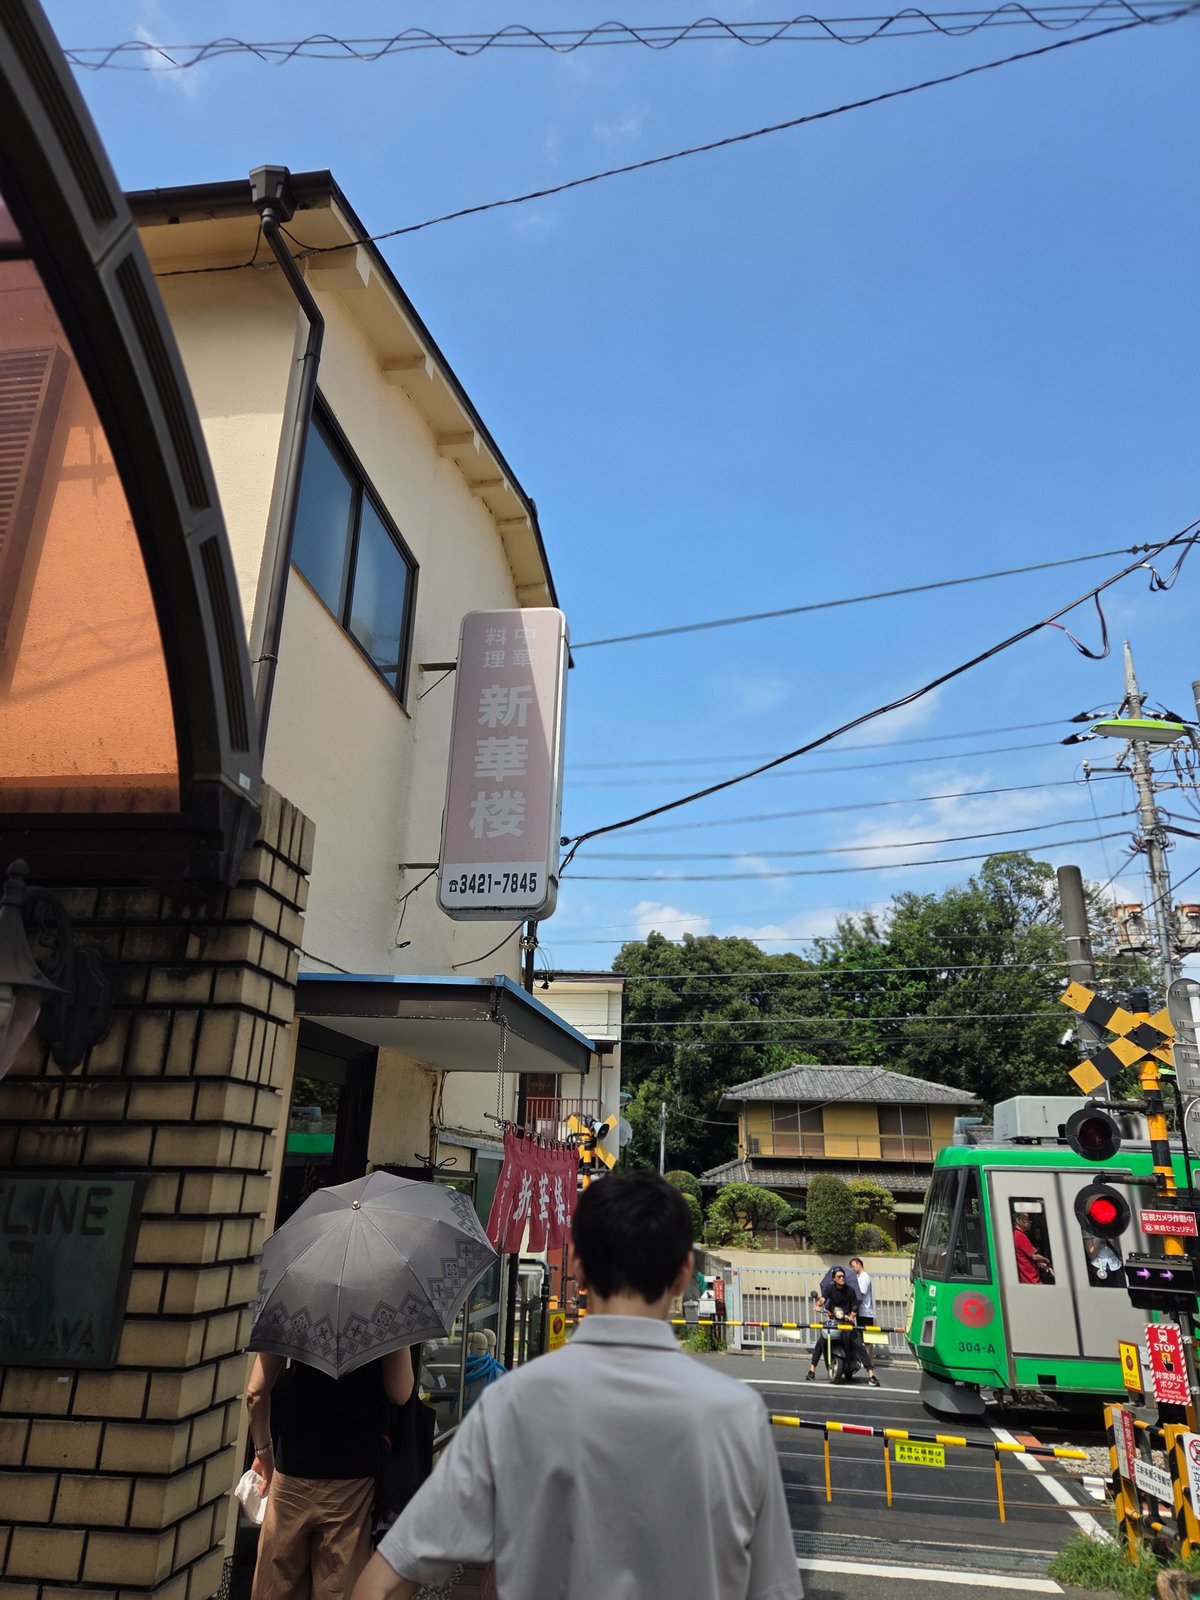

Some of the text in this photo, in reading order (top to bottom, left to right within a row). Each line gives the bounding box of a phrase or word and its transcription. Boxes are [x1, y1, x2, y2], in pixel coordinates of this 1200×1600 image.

[483, 627, 506, 668] 料理
[512, 624, 536, 668] 中華
[468, 684, 532, 840] 新華楼
[459, 872, 537, 894] 3421-7845
[0, 1184, 114, 1237] LINE
[1141, 1212, 1194, 1223] 監視カメラ作動中
[958, 1341, 996, 1355] 304-A
[1153, 1342, 1176, 1352] STOP
[1155, 1371, 1184, 1382] 非常停止
[1160, 1380, 1181, 1390] ボタン
